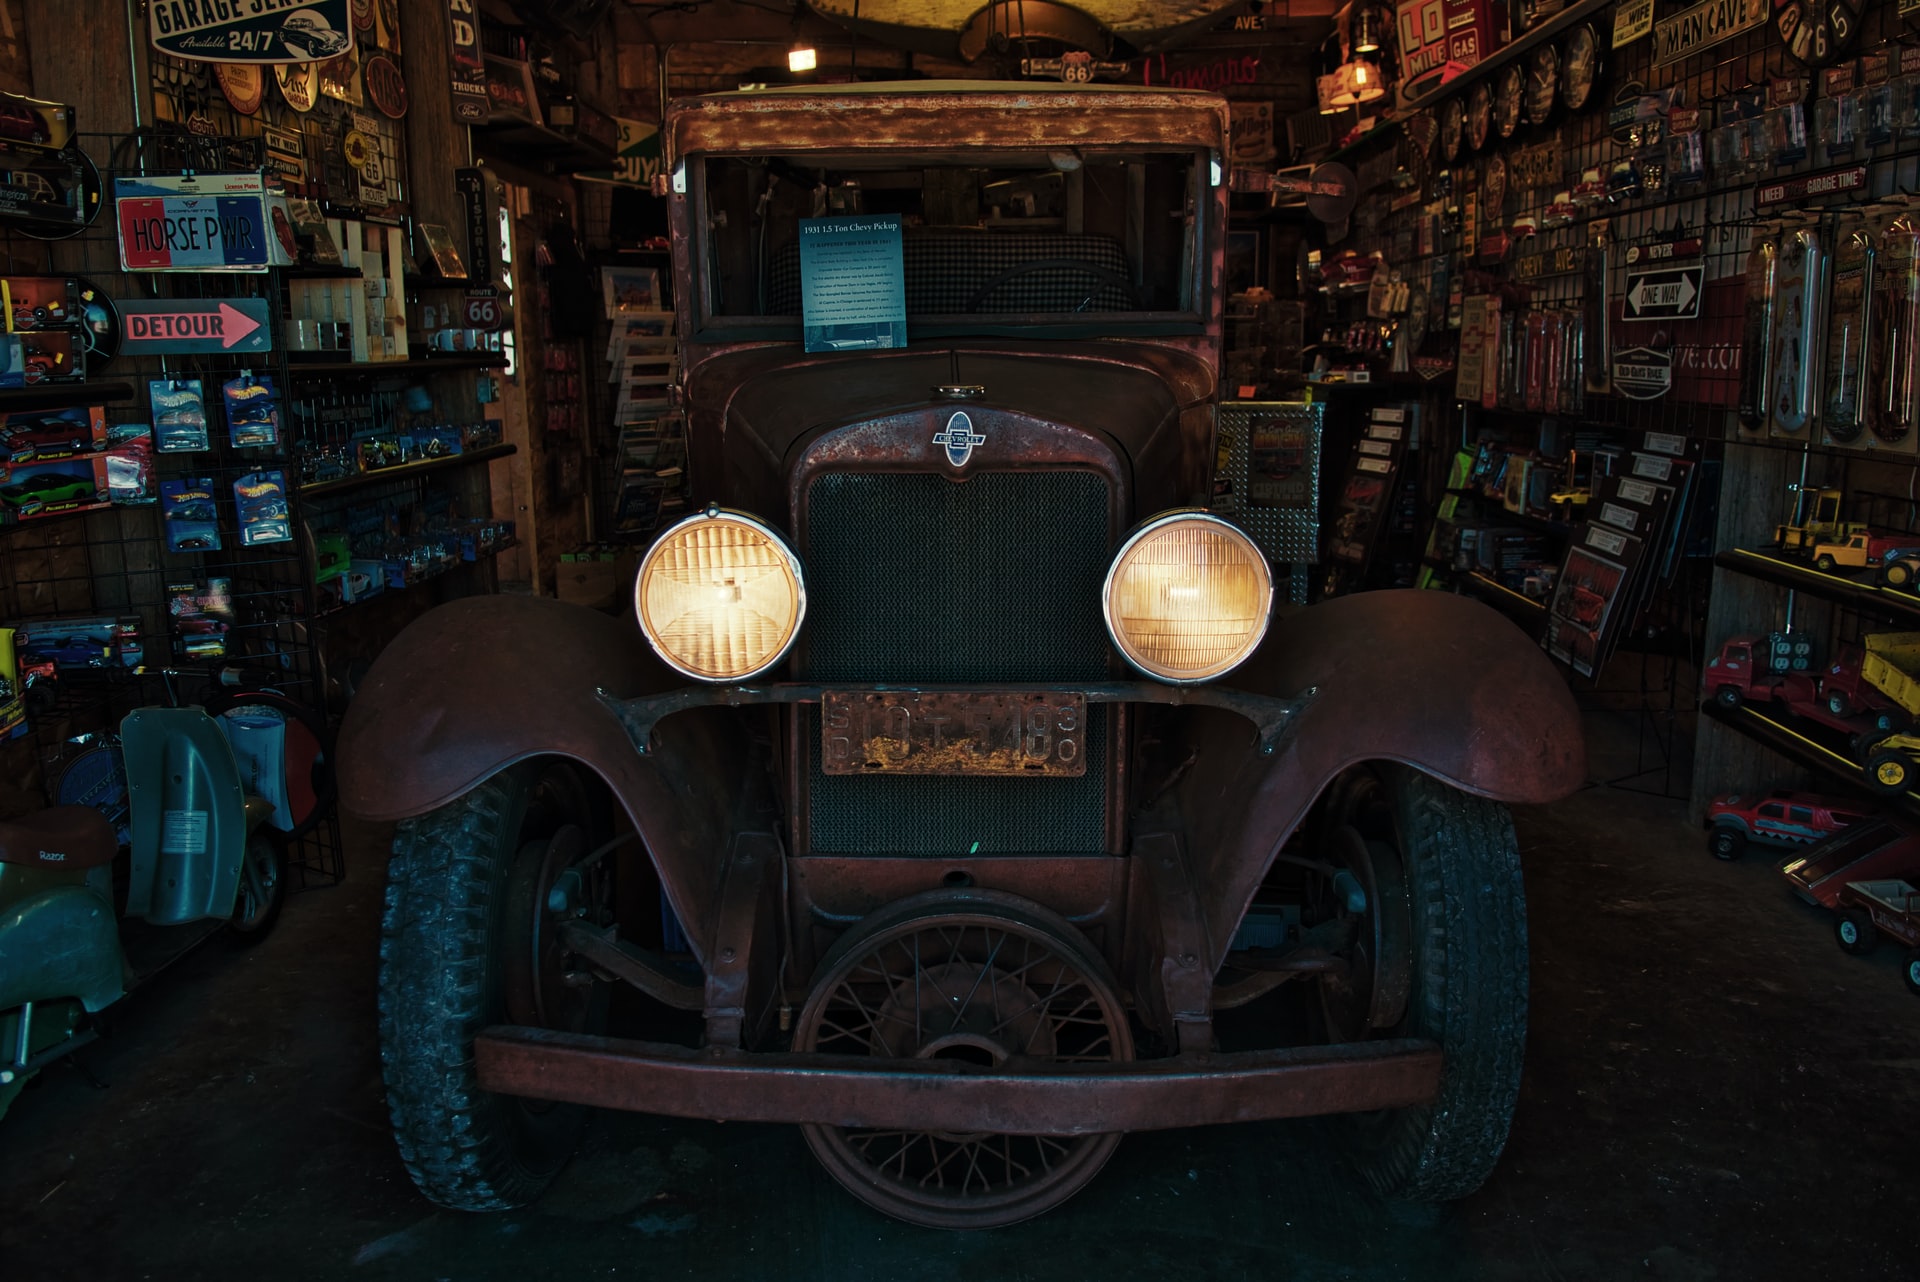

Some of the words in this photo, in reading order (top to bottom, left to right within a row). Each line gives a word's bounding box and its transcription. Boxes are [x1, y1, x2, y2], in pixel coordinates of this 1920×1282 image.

[1629, 3, 1650, 27] WIFE
[1831, 4, 1848, 39] 5
[1666, 12, 1705, 58] MAN
[1707, 0, 1747, 36] CAVE
[179, 35, 226, 49] Available
[228, 30, 274, 52] 24/7
[1453, 36, 1476, 58] GAS
[1815, 24, 1826, 59] 6
[1065, 67, 1088, 81] 66
[452, 82, 486, 95] TRUCKS
[462, 106, 480, 117] Ford
[283, 138, 298, 154] WAY
[366, 162, 379, 181] 66
[1806, 174, 1837, 195] GARAGE
[1837, 168, 1859, 190] TIME
[1764, 186, 1785, 202] NEED
[133, 216, 201, 252] HORSE
[204, 215, 255, 250] PWR
[804, 226, 821, 235] 1931
[822, 225, 834, 234] 1.5
[834, 224, 849, 233] Ton
[849, 222, 872, 233] Chevy
[873, 220, 898, 232] Pickup
[1519, 254, 1544, 278] CHEVY
[469, 288, 493, 297] ROUTE
[1640, 286, 1658, 305] ONE
[1660, 283, 1682, 304] WAY
[468, 301, 495, 323] 66
[132, 315, 224, 338] DETOUR
[1618, 366, 1631, 379] OLD
[1646, 366, 1663, 379] RULE
[938, 435, 981, 444] CHEVROLET
[39, 850, 66, 862] Razor
